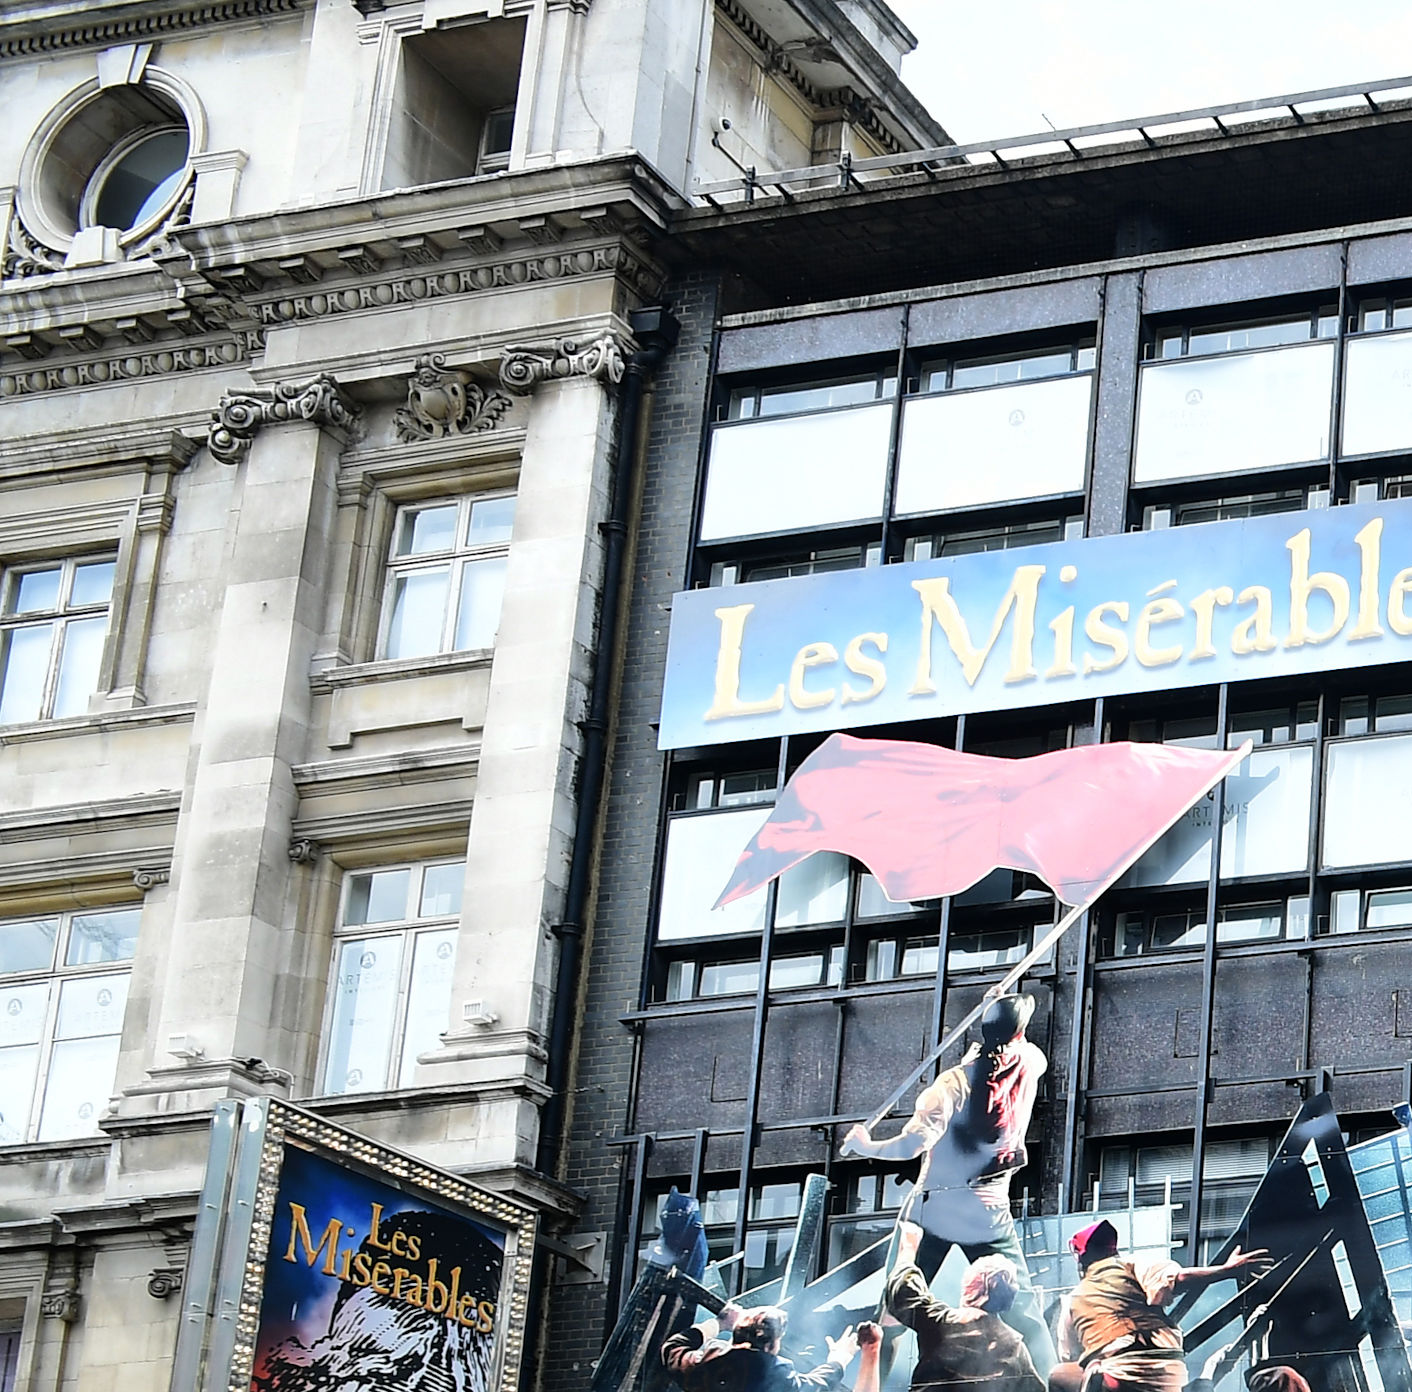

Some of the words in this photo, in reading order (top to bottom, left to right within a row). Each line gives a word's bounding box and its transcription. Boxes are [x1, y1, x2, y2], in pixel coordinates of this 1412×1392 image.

[703, 603, 889, 722] Les
[1182, 801, 1250, 818] ARTMIS
[283, 1201, 495, 1334] Misérables
[366, 1202, 422, 1261] Les
